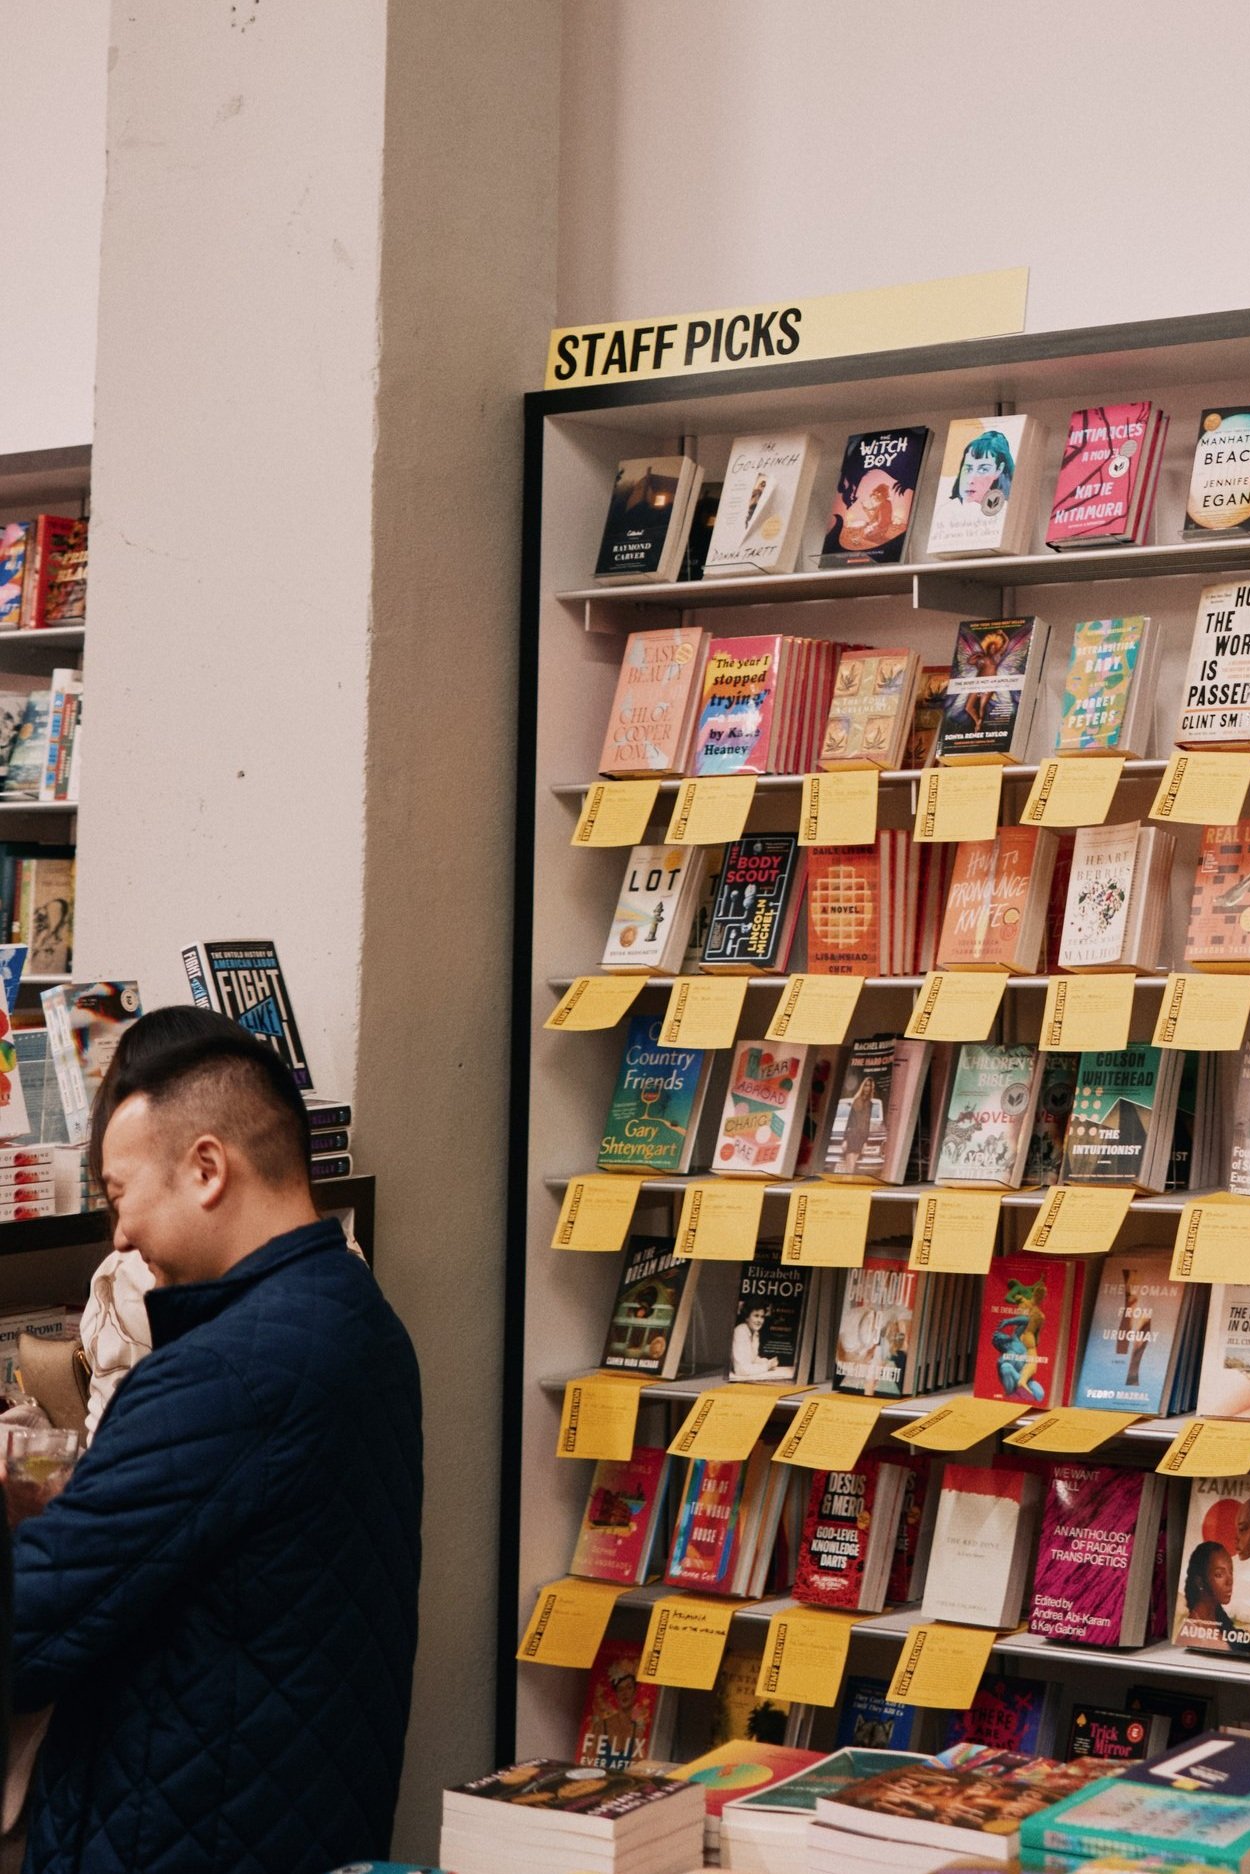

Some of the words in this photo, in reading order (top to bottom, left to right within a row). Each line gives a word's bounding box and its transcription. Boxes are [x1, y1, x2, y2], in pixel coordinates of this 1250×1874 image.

[554, 324, 678, 381] STAFF
[684, 307, 801, 366] PICKS
[1206, 611, 1235, 633] THE
[713, 671, 767, 686] stopped
[1201, 660, 1217, 681] IS
[928, 775, 939, 814] SELECTION
[1033, 801, 1047, 821] STAFF
[1041, 765, 1058, 801] SELECTION
[1162, 795, 1176, 816] STAFF
[1170, 758, 1188, 795] SELECTION
[925, 815, 935, 836] STAFF
[1206, 826, 1241, 844] REAL
[737, 856, 782, 871] BODY
[629, 868, 681, 892] LOT
[726, 869, 780, 884] SCOUT
[747, 898, 767, 952] LINCOLN
[266, 950, 274, 958] OF
[213, 959, 252, 970] AMERICAN
[254, 958, 277, 968] LABOR
[244, 999, 280, 1034] LIKE
[626, 1046, 694, 1071] Country
[624, 1070, 684, 1091] Friends
[1082, 1070, 1154, 1087] WHITEHEAD
[624, 1119, 658, 1138] Gary
[1098, 1128, 1120, 1139] THE
[1186, 1209, 1203, 1251] SELECTION
[1182, 1252, 1194, 1277] STAFF
[741, 1279, 804, 1297] BISHOP
[1229, 1305, 1248, 1320] THE
[1227, 1318, 1239, 1331] IN
[828, 1472, 866, 1495] DESUS
[1197, 1478, 1244, 1495] ZAMI
[816, 1526, 859, 1541] GOD-LEVEL
[811, 1540, 860, 1556] KNOWLEDGE
[820, 1554, 847, 1569] DARTS
[1180, 1625, 1219, 1641] AUDRE
[1090, 1722, 1119, 1741] Trick
[581, 1733, 646, 1759] FELIX
[1094, 1740, 1132, 1755] Mirror
